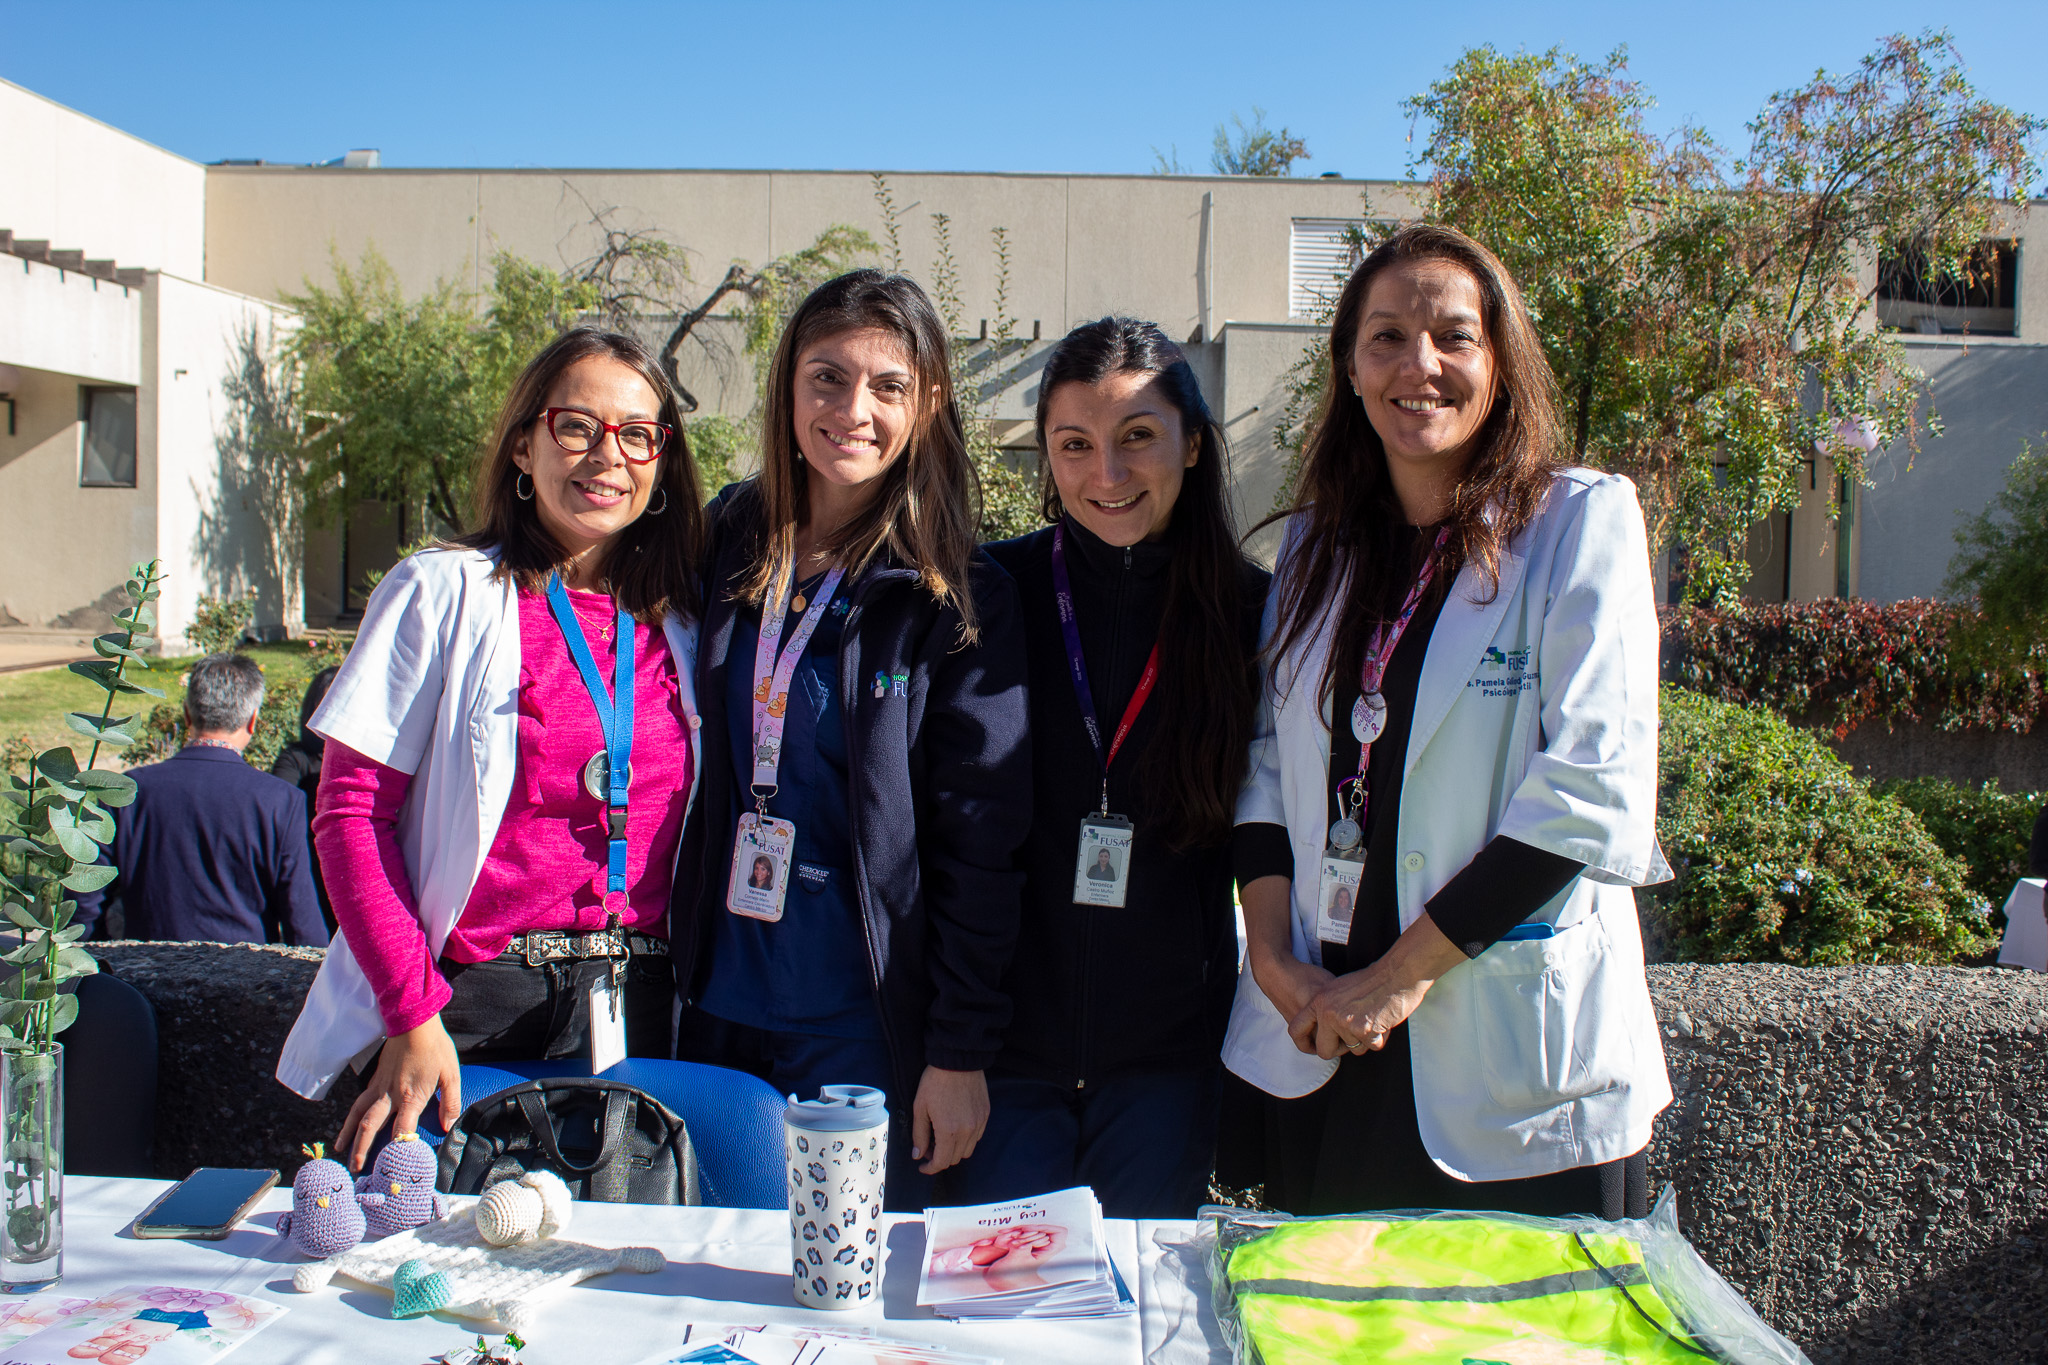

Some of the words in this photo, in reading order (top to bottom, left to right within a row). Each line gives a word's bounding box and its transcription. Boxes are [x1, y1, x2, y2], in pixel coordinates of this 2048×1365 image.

[1507, 651, 1531, 671] FUST
[1475, 678, 1505, 687] Pamela
[1522, 672, 1540, 680] Guzm
[759, 842, 785, 855] FUSAT
[1100, 836, 1131, 848] FUSAT
[798, 864, 828, 877] CHEROKEE
[748, 889, 768, 897] Vanessa
